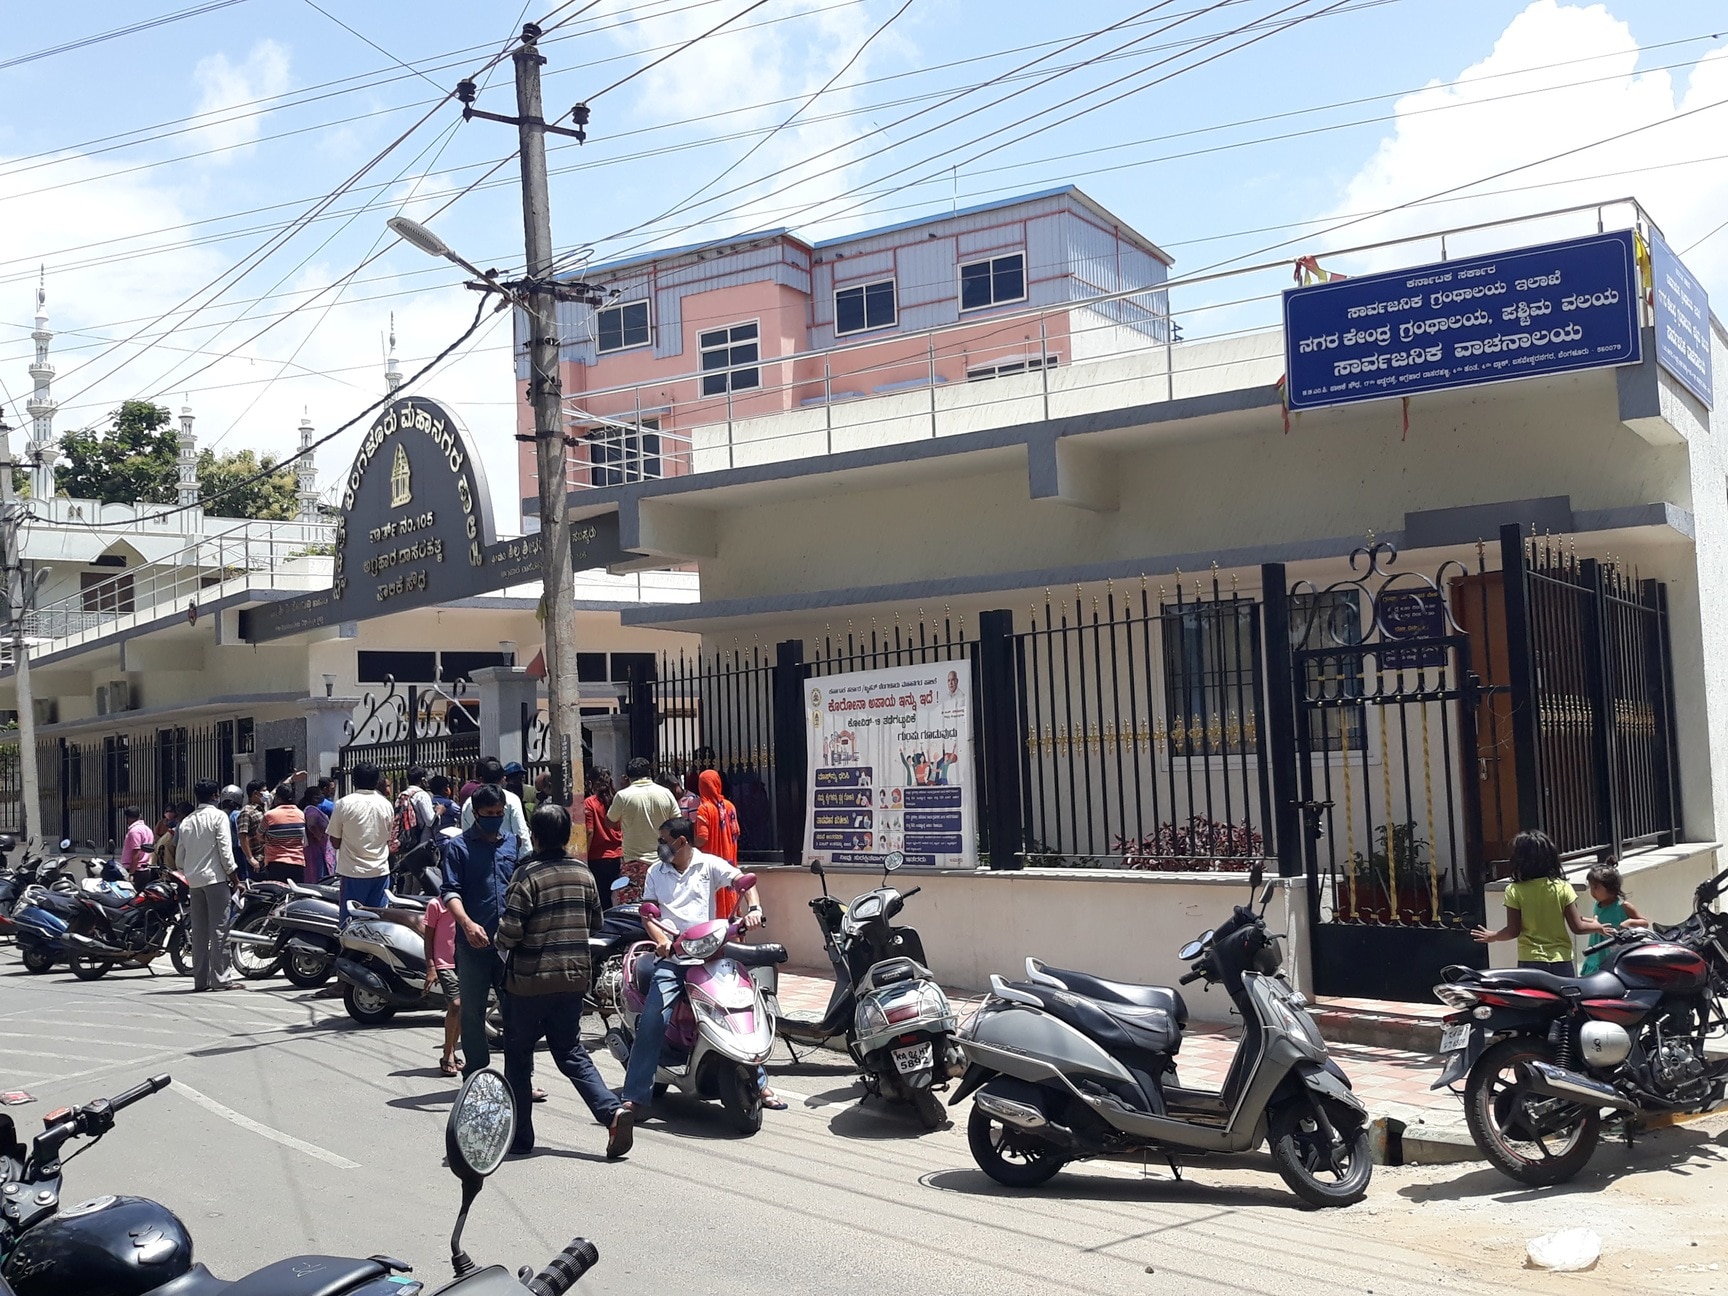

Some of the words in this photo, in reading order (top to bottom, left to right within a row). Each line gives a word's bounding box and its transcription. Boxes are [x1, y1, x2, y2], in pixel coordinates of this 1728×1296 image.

[1347, 293, 1423, 319] ಸಾರ್ವಜನಿಕ
[1430, 281, 1507, 311] ಗ್ರಂಥಾಲಯ
[1515, 271, 1561, 292] ಇಲಾಖೆ
[1407, 273, 1453, 289] ಕರ್ನಾಟಕ
[1458, 264, 1496, 281] ಸರ್ಕಾರ
[1299, 331, 1338, 353] ನಗರ
[1343, 321, 1391, 346] ಕೇಂದ್ರ
[1502, 298, 1552, 327] ಪಶ್ಚಿಮ
[1561, 289, 1619, 313] ವಲಯ
[1334, 341, 1442, 377] ಸಾರ್ವಜನಿಕ
[1454, 321, 1583, 358] ವಾಚನಾಲಯ
[401, 401, 463, 473] ಮಹಾನಗರ
[363, 548, 397, 577] ಅಗ್ರಹಾರ
[901, 1056, 929, 1070] 5892
